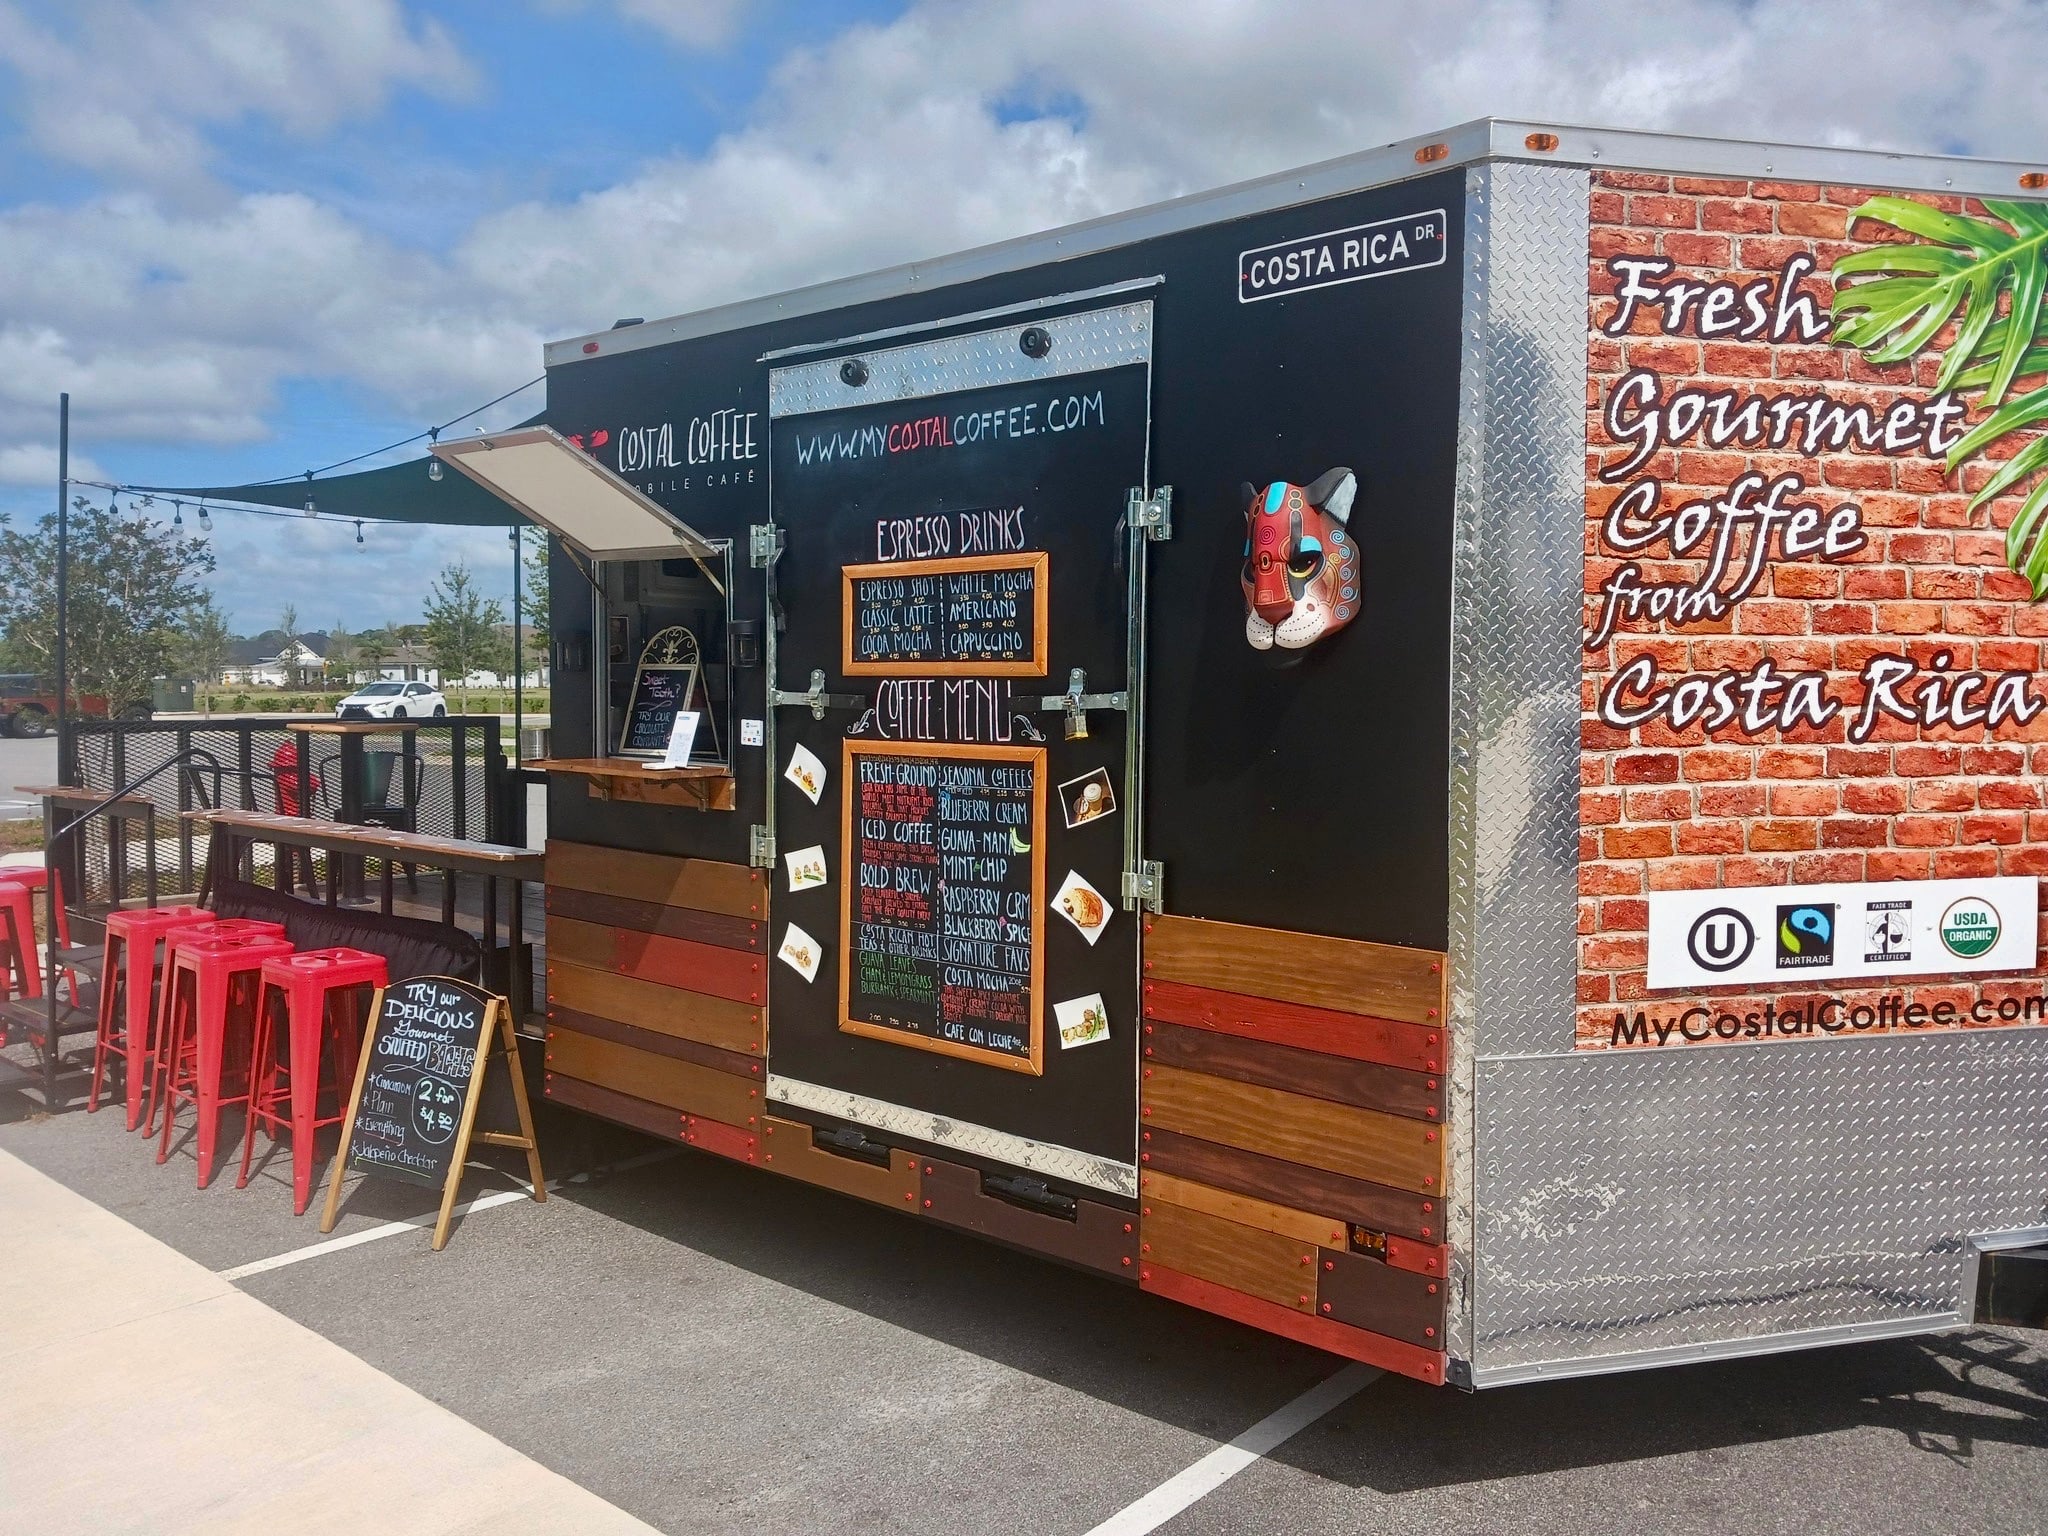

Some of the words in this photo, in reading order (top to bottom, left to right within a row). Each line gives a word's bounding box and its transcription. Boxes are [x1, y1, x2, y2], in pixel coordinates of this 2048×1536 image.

[1250, 245, 1335, 289] COSTA
[1343, 229, 1410, 270] RICA
[1415, 223, 1435, 241] DR
[1608, 254, 1831, 340] Fresh
[795, 390, 1105, 465] WWW.MYCOSTALCOFFEE.COM
[1603, 371, 1965, 480] Gourmet
[618, 422, 682, 473] COSTAL
[687, 408, 759, 465] COFFEE
[876, 515, 950, 561] ESPRESSO
[960, 506, 1025, 553] DRINKS
[1606, 474, 1866, 601] Coffee
[860, 579, 905, 602] ESPRESSO
[911, 576, 936, 597] SHOT
[948, 573, 988, 594] WHITE
[993, 570, 1034, 592] MOCHA
[861, 607, 898, 628] CLASSIC
[903, 604, 935, 627] LATTE
[949, 599, 1017, 622] AMERICANO
[1586, 566, 1728, 650] from
[861, 633, 890, 655] COCOA
[893, 630, 932, 652] MOCHA
[950, 631, 1023, 654] CAPPUCCINO
[875, 679, 935, 739] COFFEE
[943, 679, 1012, 742] MENU
[1601, 657, 1839, 732] Costa
[1851, 652, 2043, 742] Rica
[860, 761, 937, 788] FRESH-GROUND
[941, 765, 989, 787] SEASONAL
[991, 768, 1033, 788] COFFEES
[940, 797, 990, 822] BLUEBERRY
[995, 802, 1028, 825] CREAM
[861, 817, 887, 840] ICED
[893, 821, 933, 845] COFFEE
[860, 862, 889, 889] BOLD
[895, 866, 932, 895] BREW
[943, 854, 976, 881] MINT
[980, 857, 1008, 882] CHIP
[942, 885, 1001, 916] RASPBERRY
[1005, 891, 1031, 921] CRM
[1871, 902, 1886, 910] FAIR
[1887, 901, 1907, 909] TRADE
[943, 913, 1002, 941] BLACKBERRY
[1953, 911, 1989, 926] USDA
[858, 936, 878, 952] TEAS
[860, 923, 886, 940] COSTA
[888, 927, 914, 945] RICAN
[918, 931, 935, 948] HOT
[1948, 929, 1993, 943] ORGANIC
[941, 937, 999, 969] SIGNATURE
[1004, 946, 1031, 972] FAVS
[1778, 953, 1832, 966] FAIRTRADE
[944, 966, 974, 988] COSTA
[976, 971, 1009, 993] MOCHA
[404, 983, 438, 1007] TRY
[440, 992, 461, 1006] our
[392, 1018, 456, 1045] Gourmet
[1610, 993, 2048, 1047] MyCostalCoffee.com
[377, 1034, 427, 1062] STUFFED
[944, 1021, 965, 1041] CAFE
[968, 1026, 984, 1045] CON
[988, 1031, 1012, 1051] LECHE
[371, 1089, 395, 1114] Plain
[418, 1080, 432, 1102] 2
[435, 1089, 455, 1104] for
[364, 1116, 406, 1146] Everything
